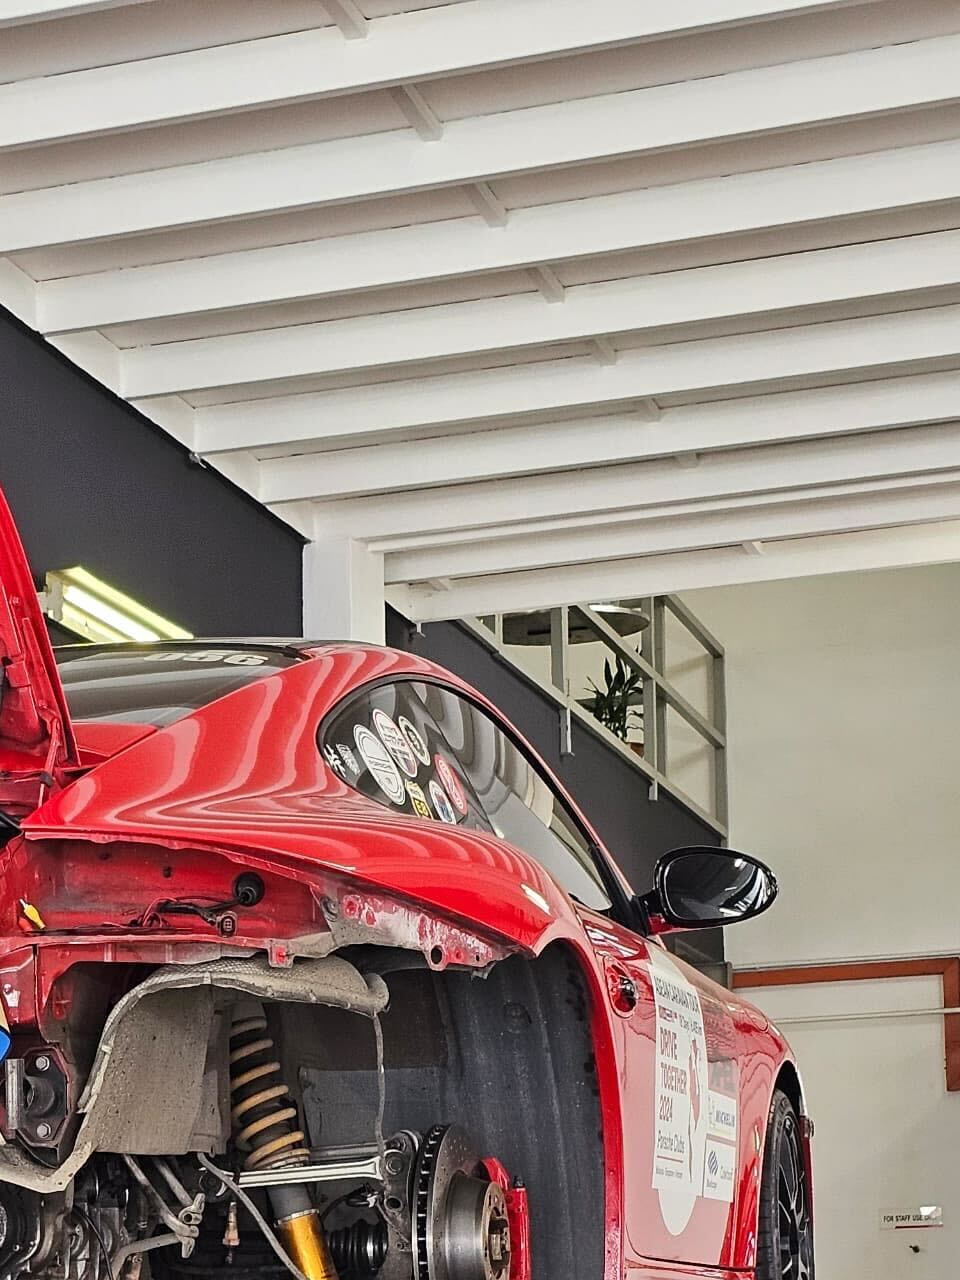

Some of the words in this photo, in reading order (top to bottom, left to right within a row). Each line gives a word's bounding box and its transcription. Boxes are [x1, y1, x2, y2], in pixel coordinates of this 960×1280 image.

[660, 1026, 677, 1060] DRIVE
[660, 1062, 688, 1095] TOGETHER
[659, 1094, 673, 1122] 2024
[883, 1215, 894, 1223] FOR
[895, 1214, 911, 1222] STAFF
